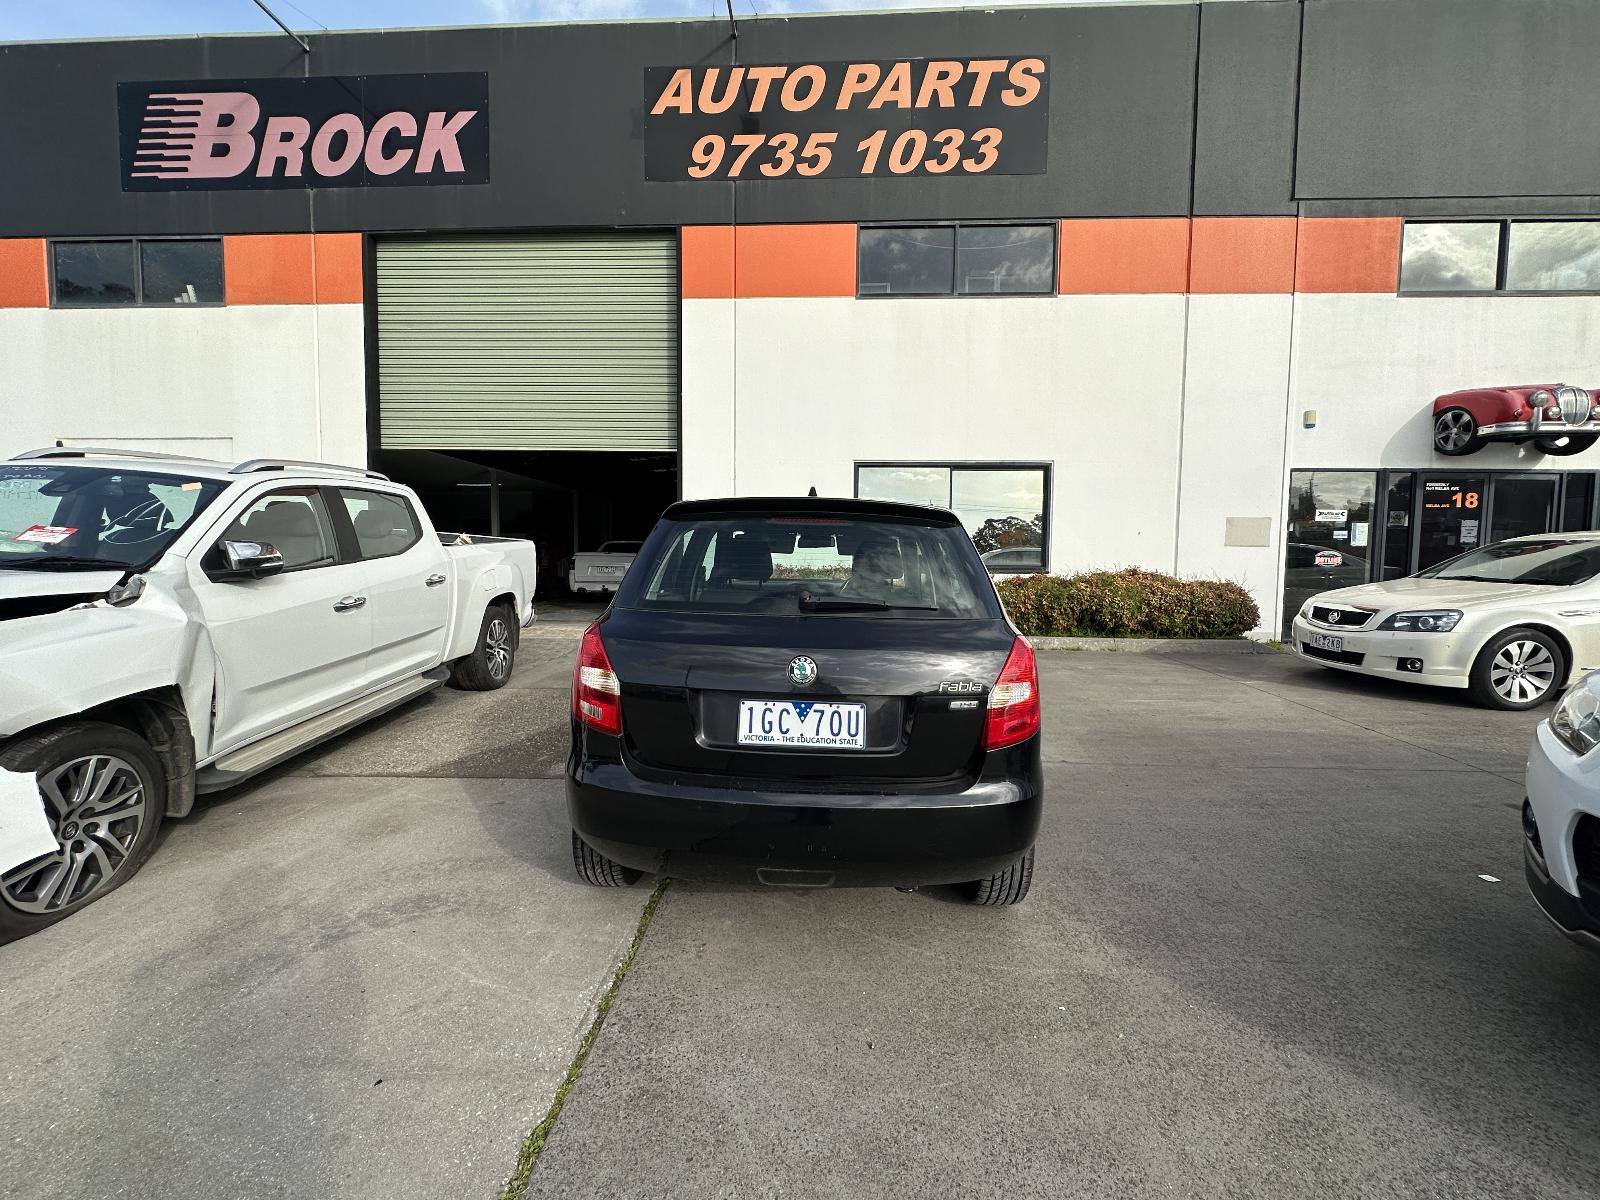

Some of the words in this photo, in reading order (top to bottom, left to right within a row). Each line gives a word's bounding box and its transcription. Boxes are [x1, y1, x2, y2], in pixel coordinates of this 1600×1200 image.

[649, 64, 827, 115] AUTO
[835, 57, 1046, 110] PARTS
[131, 91, 479, 179] BROCK
[687, 132, 838, 178] 9735
[855, 127, 1004, 174] 1033
[1451, 491, 1479, 509] 18
[939, 681, 983, 692] Fabia
[747, 706, 791, 735] 1GC
[743, 734, 775, 742] VICTORIA
[782, 735, 795, 743] THE
[796, 736, 837, 745] EDUCATION
[838, 738, 859, 746] STATE
